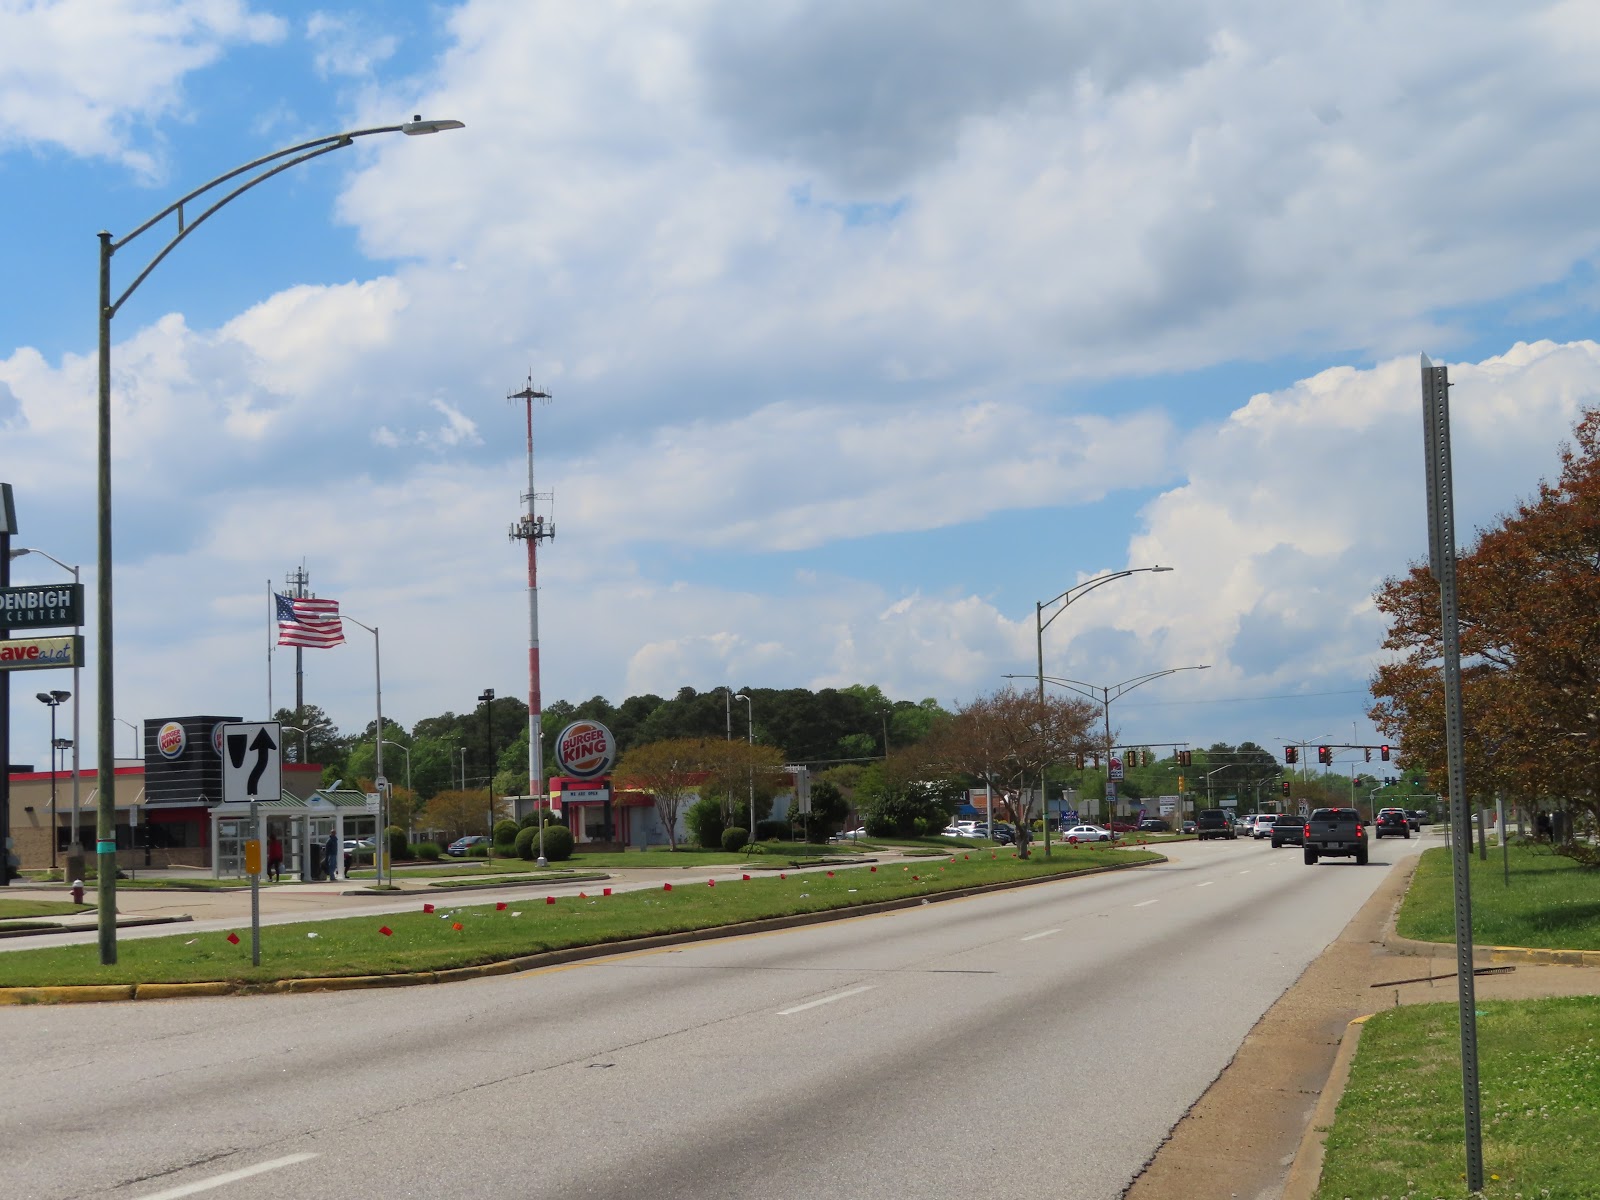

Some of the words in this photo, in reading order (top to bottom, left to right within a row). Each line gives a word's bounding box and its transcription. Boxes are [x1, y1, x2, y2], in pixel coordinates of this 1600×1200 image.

[6, 609, 66, 622] CENTER
[0, 645, 39, 661] ave
[161, 730, 180, 742] BURGER
[161, 736, 181, 750] KING
[563, 730, 603, 751] BURGER
[563, 740, 606, 763] KING
